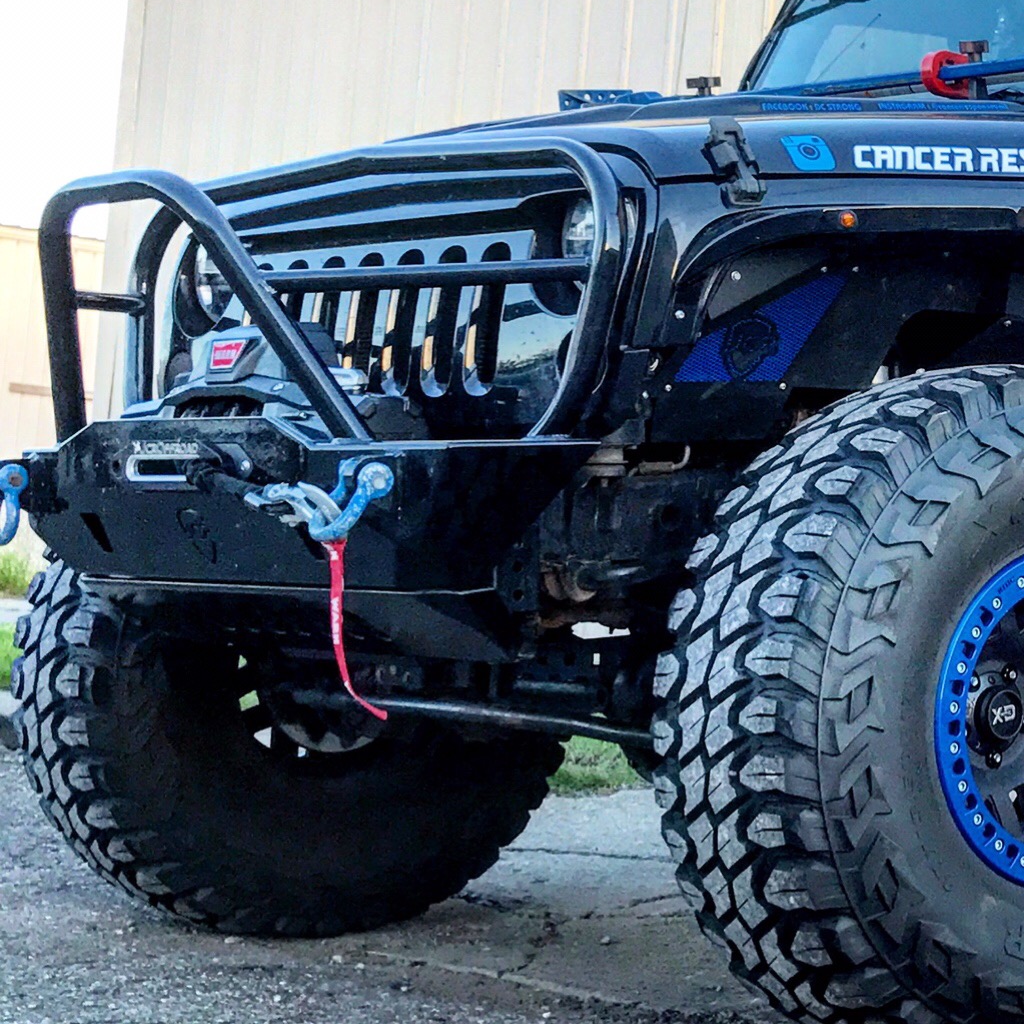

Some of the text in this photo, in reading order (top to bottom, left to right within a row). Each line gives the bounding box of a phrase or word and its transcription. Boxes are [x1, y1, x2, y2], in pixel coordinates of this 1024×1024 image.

[762, 102, 809, 111] FACEBOOK
[853, 145, 974, 173] CANCER
[331, 597, 340, 645] WARN
